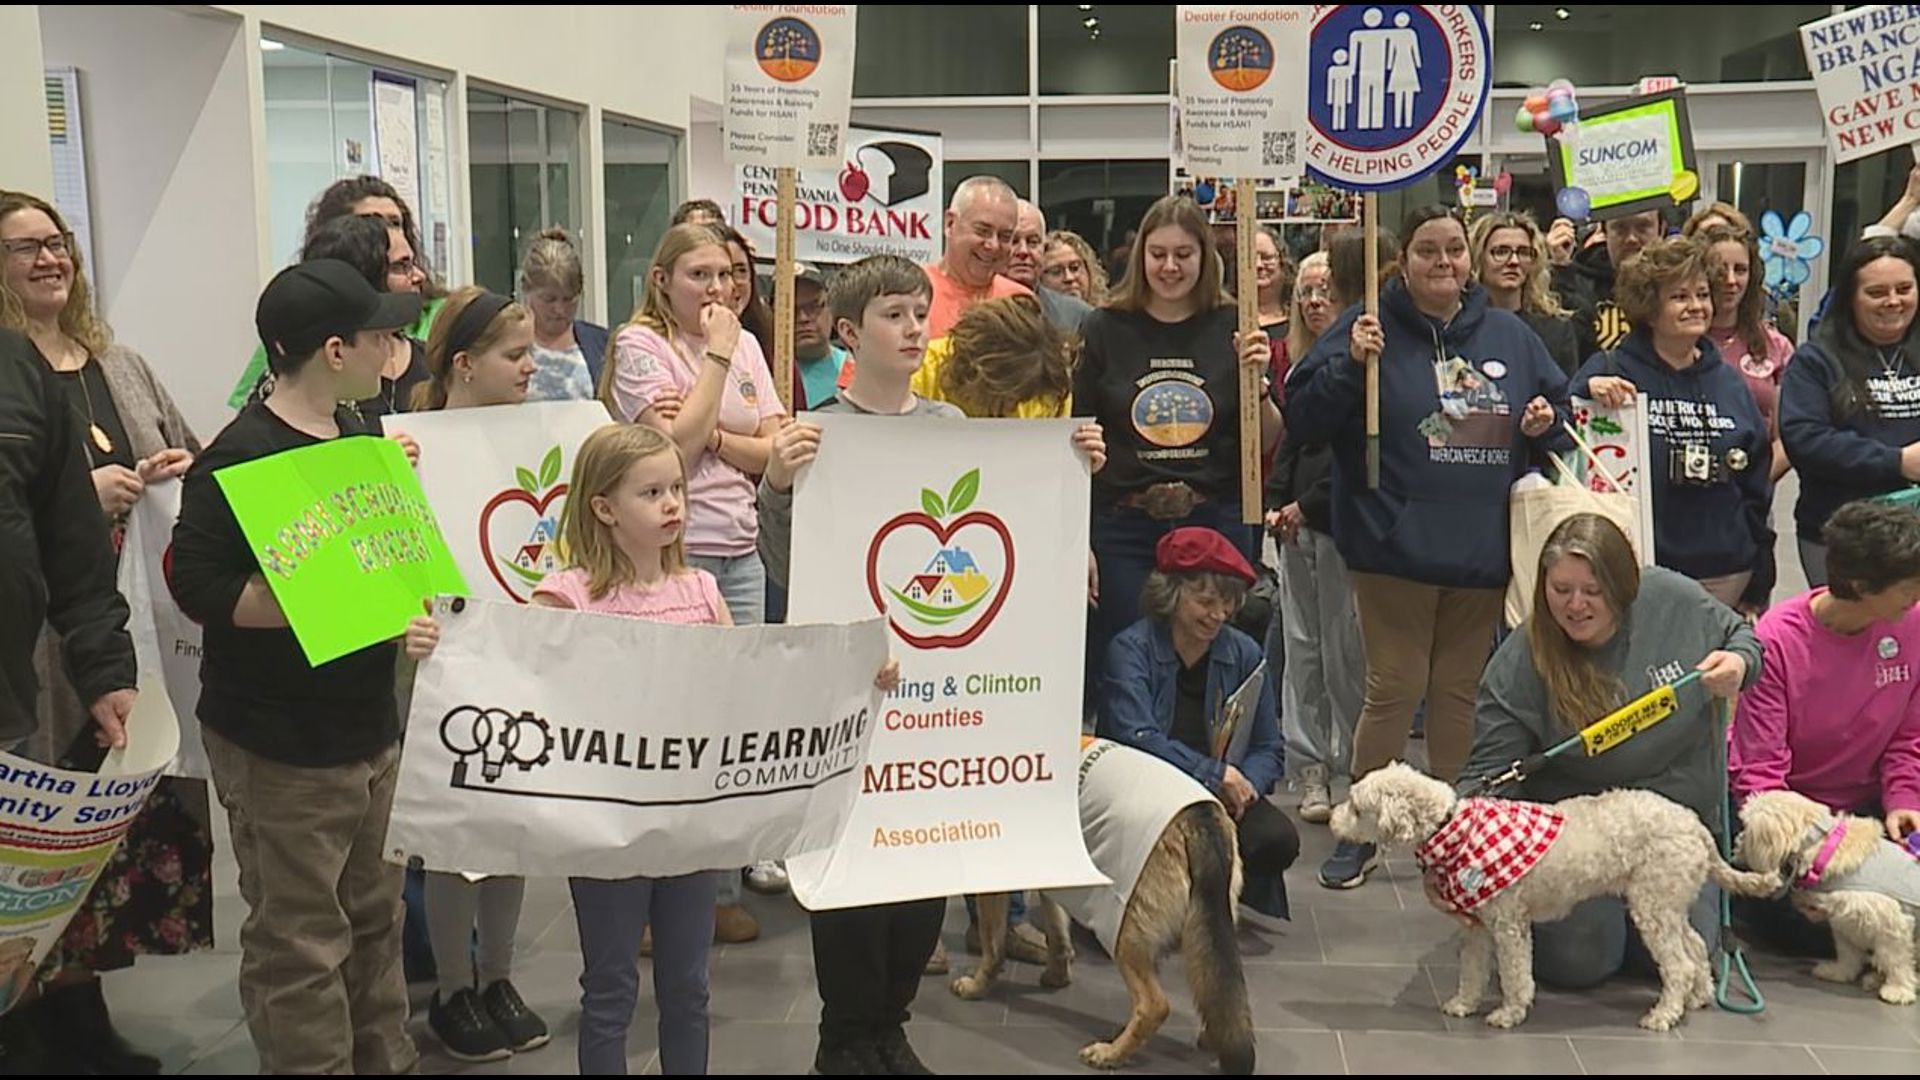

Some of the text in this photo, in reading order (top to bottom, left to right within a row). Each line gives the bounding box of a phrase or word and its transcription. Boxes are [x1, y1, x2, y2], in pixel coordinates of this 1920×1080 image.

[1185, 10, 1225, 22] Deater
[1230, 10, 1299, 22] Foundation
[1437, 5, 1476, 81] ORKERS
[744, 85, 765, 93] Years
[777, 86, 820, 97] Promoting
[1198, 97, 1218, 105] Years
[1220, 96, 1229, 105] of
[1231, 97, 1274, 107] Promoting
[730, 97, 774, 106] Awareness
[784, 98, 813, 109] Raising
[730, 107, 754, 117] Funds
[756, 108, 767, 117] for
[1186, 109, 1227, 117] Awareness
[1238, 109, 1267, 118] Raising
[1829, 88, 1903, 126] GAVE
[730, 131, 794, 142] Please Consider
[1186, 121, 1207, 129] Funds
[1210, 121, 1221, 129] for
[1416, 91, 1475, 159] PEOPLE
[1837, 117, 1894, 151] NEW
[730, 143, 767, 154] Donating
[1187, 144, 1250, 153] Please Consider
[1188, 155, 1222, 165] Donating
[1578, 138, 1658, 167] SUNCOM
[743, 164, 804, 183] CENTL
[1327, 152, 1413, 175] HELPING
[743, 181, 839, 203] PENNLVANIA
[743, 197, 931, 240] FOOD BANK
[816, 240, 829, 253] No
[831, 240, 850, 254] One
[942, 676, 958, 697] &
[965, 673, 1042, 696] Clinton
[885, 708, 984, 732] Counties
[1604, 710, 1640, 736] ADOPT
[1641, 700, 1659, 715] ME
[560, 707, 868, 770] VALLEY LEARNING
[87, 770, 157, 798] Lloyd
[861, 753, 1053, 794] MESCHOOL
[0, 796, 62, 823] nity
[872, 819, 1001, 848] Association
